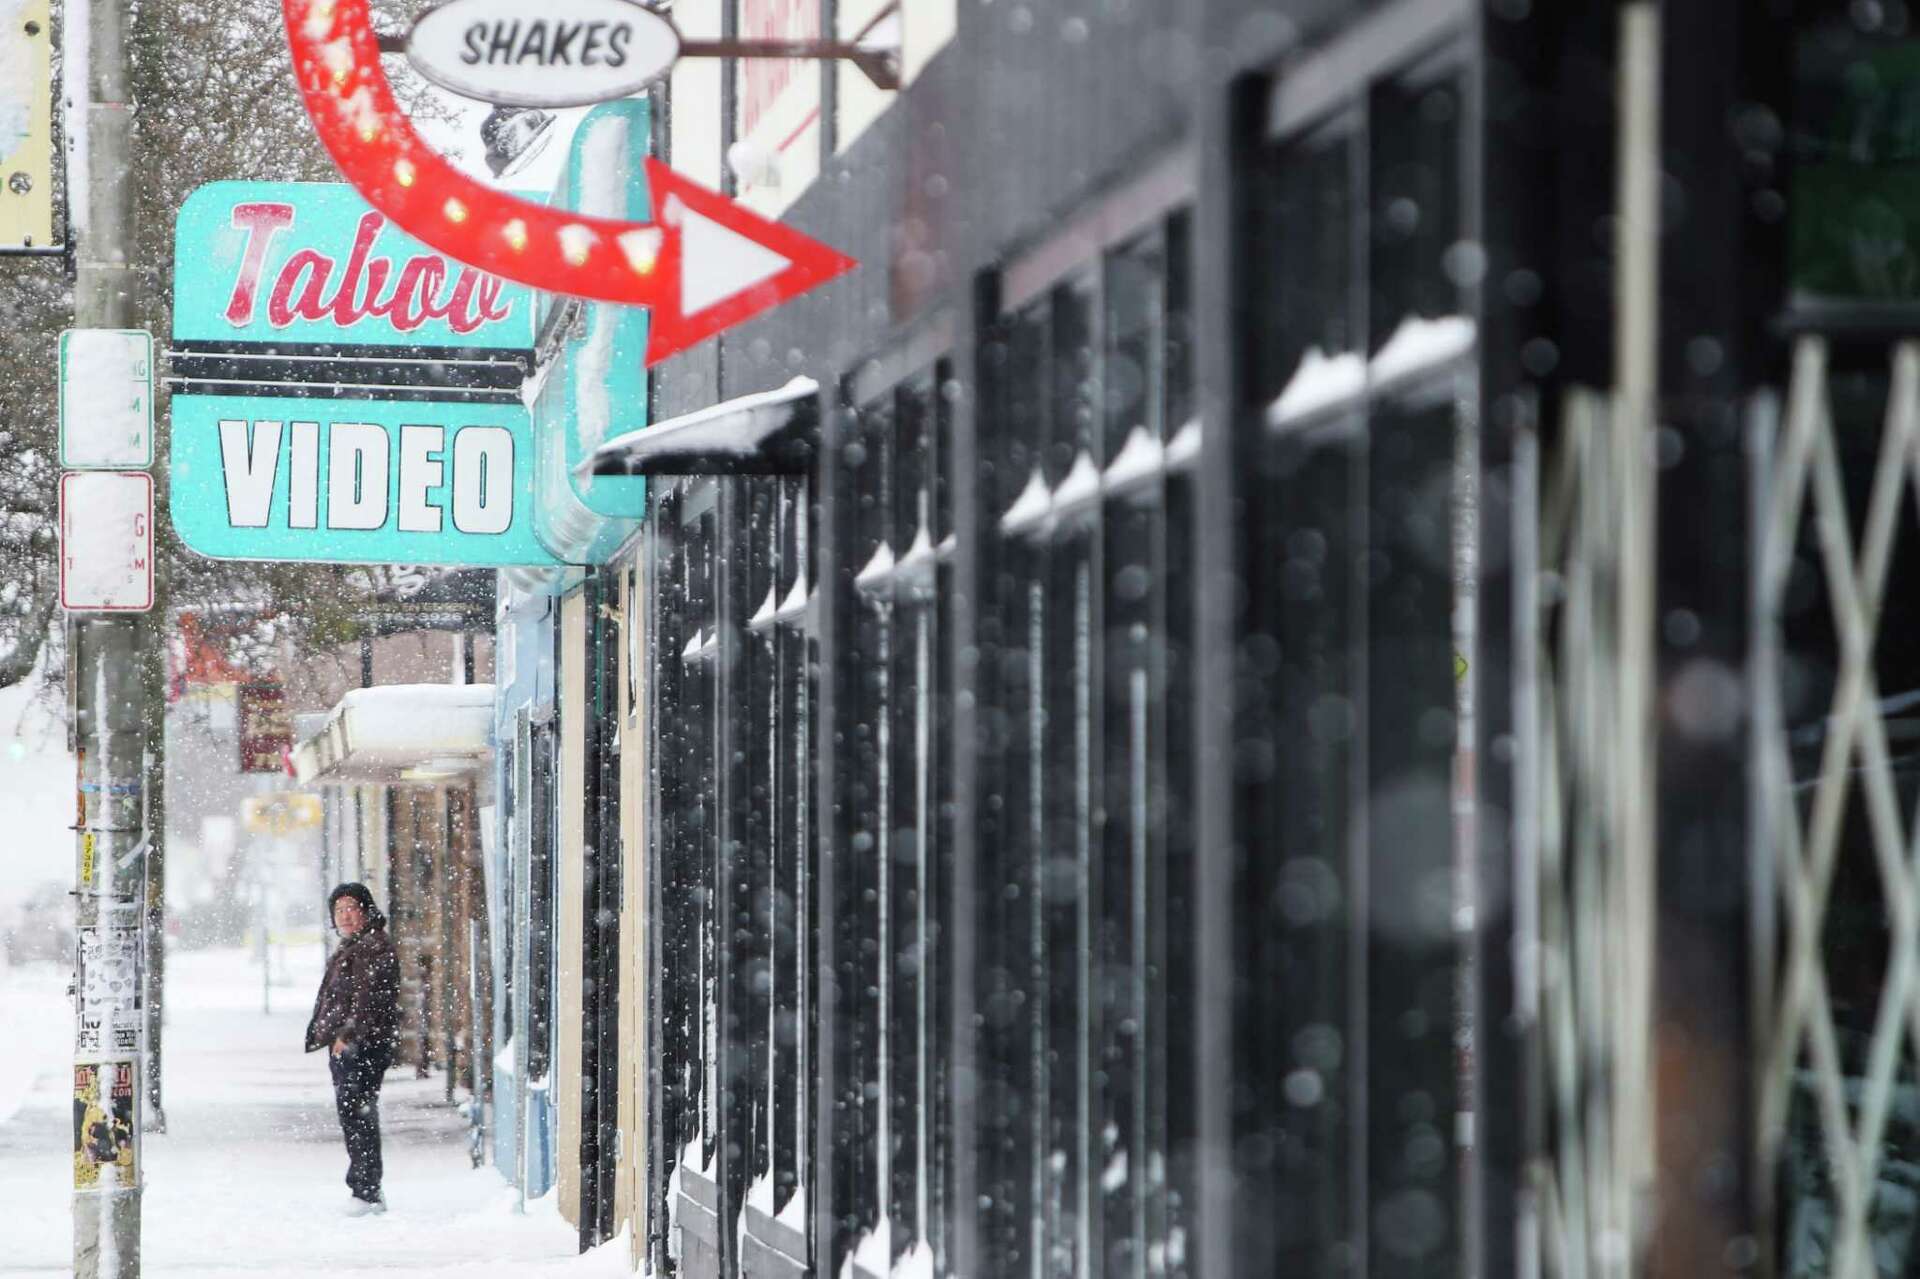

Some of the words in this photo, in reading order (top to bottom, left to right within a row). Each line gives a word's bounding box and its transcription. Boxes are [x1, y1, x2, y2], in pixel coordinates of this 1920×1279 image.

[459, 19, 633, 67] SHAKES
[225, 203, 513, 335] Taboo
[218, 419, 514, 535] VIDEO
[418, 612, 464, 622] 3926
